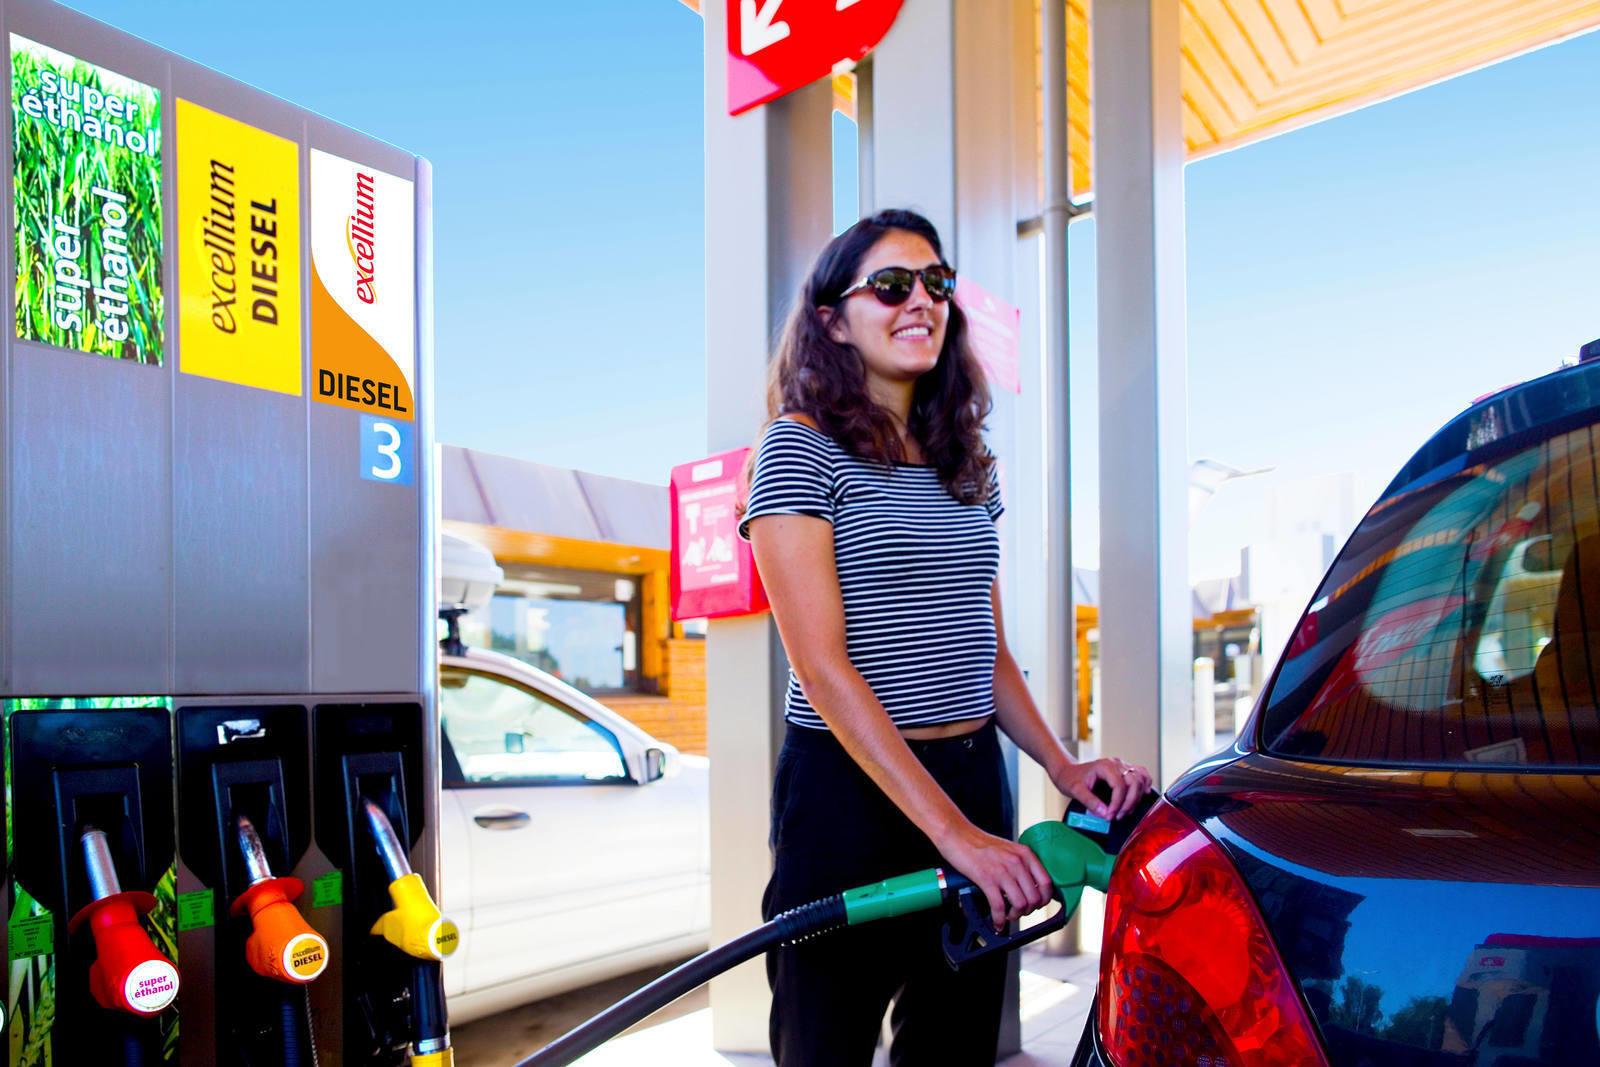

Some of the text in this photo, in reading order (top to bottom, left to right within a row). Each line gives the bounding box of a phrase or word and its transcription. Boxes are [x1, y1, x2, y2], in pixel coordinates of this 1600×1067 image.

[22, 89, 157, 156] éthanol
[40, 69, 139, 122] super
[93, 186, 128, 342] éthanol
[203, 158, 236, 335] excellium
[251, 198, 278, 326] DIESEL
[351, 172, 375, 305] excellium
[55, 214, 90, 332] super
[319, 368, 407, 413] DIESEL
[371, 422, 402, 480] 3
[135, 981, 173, 998] éthanol
[139, 975, 167, 988] super
[294, 953, 322, 968] DIESEL
